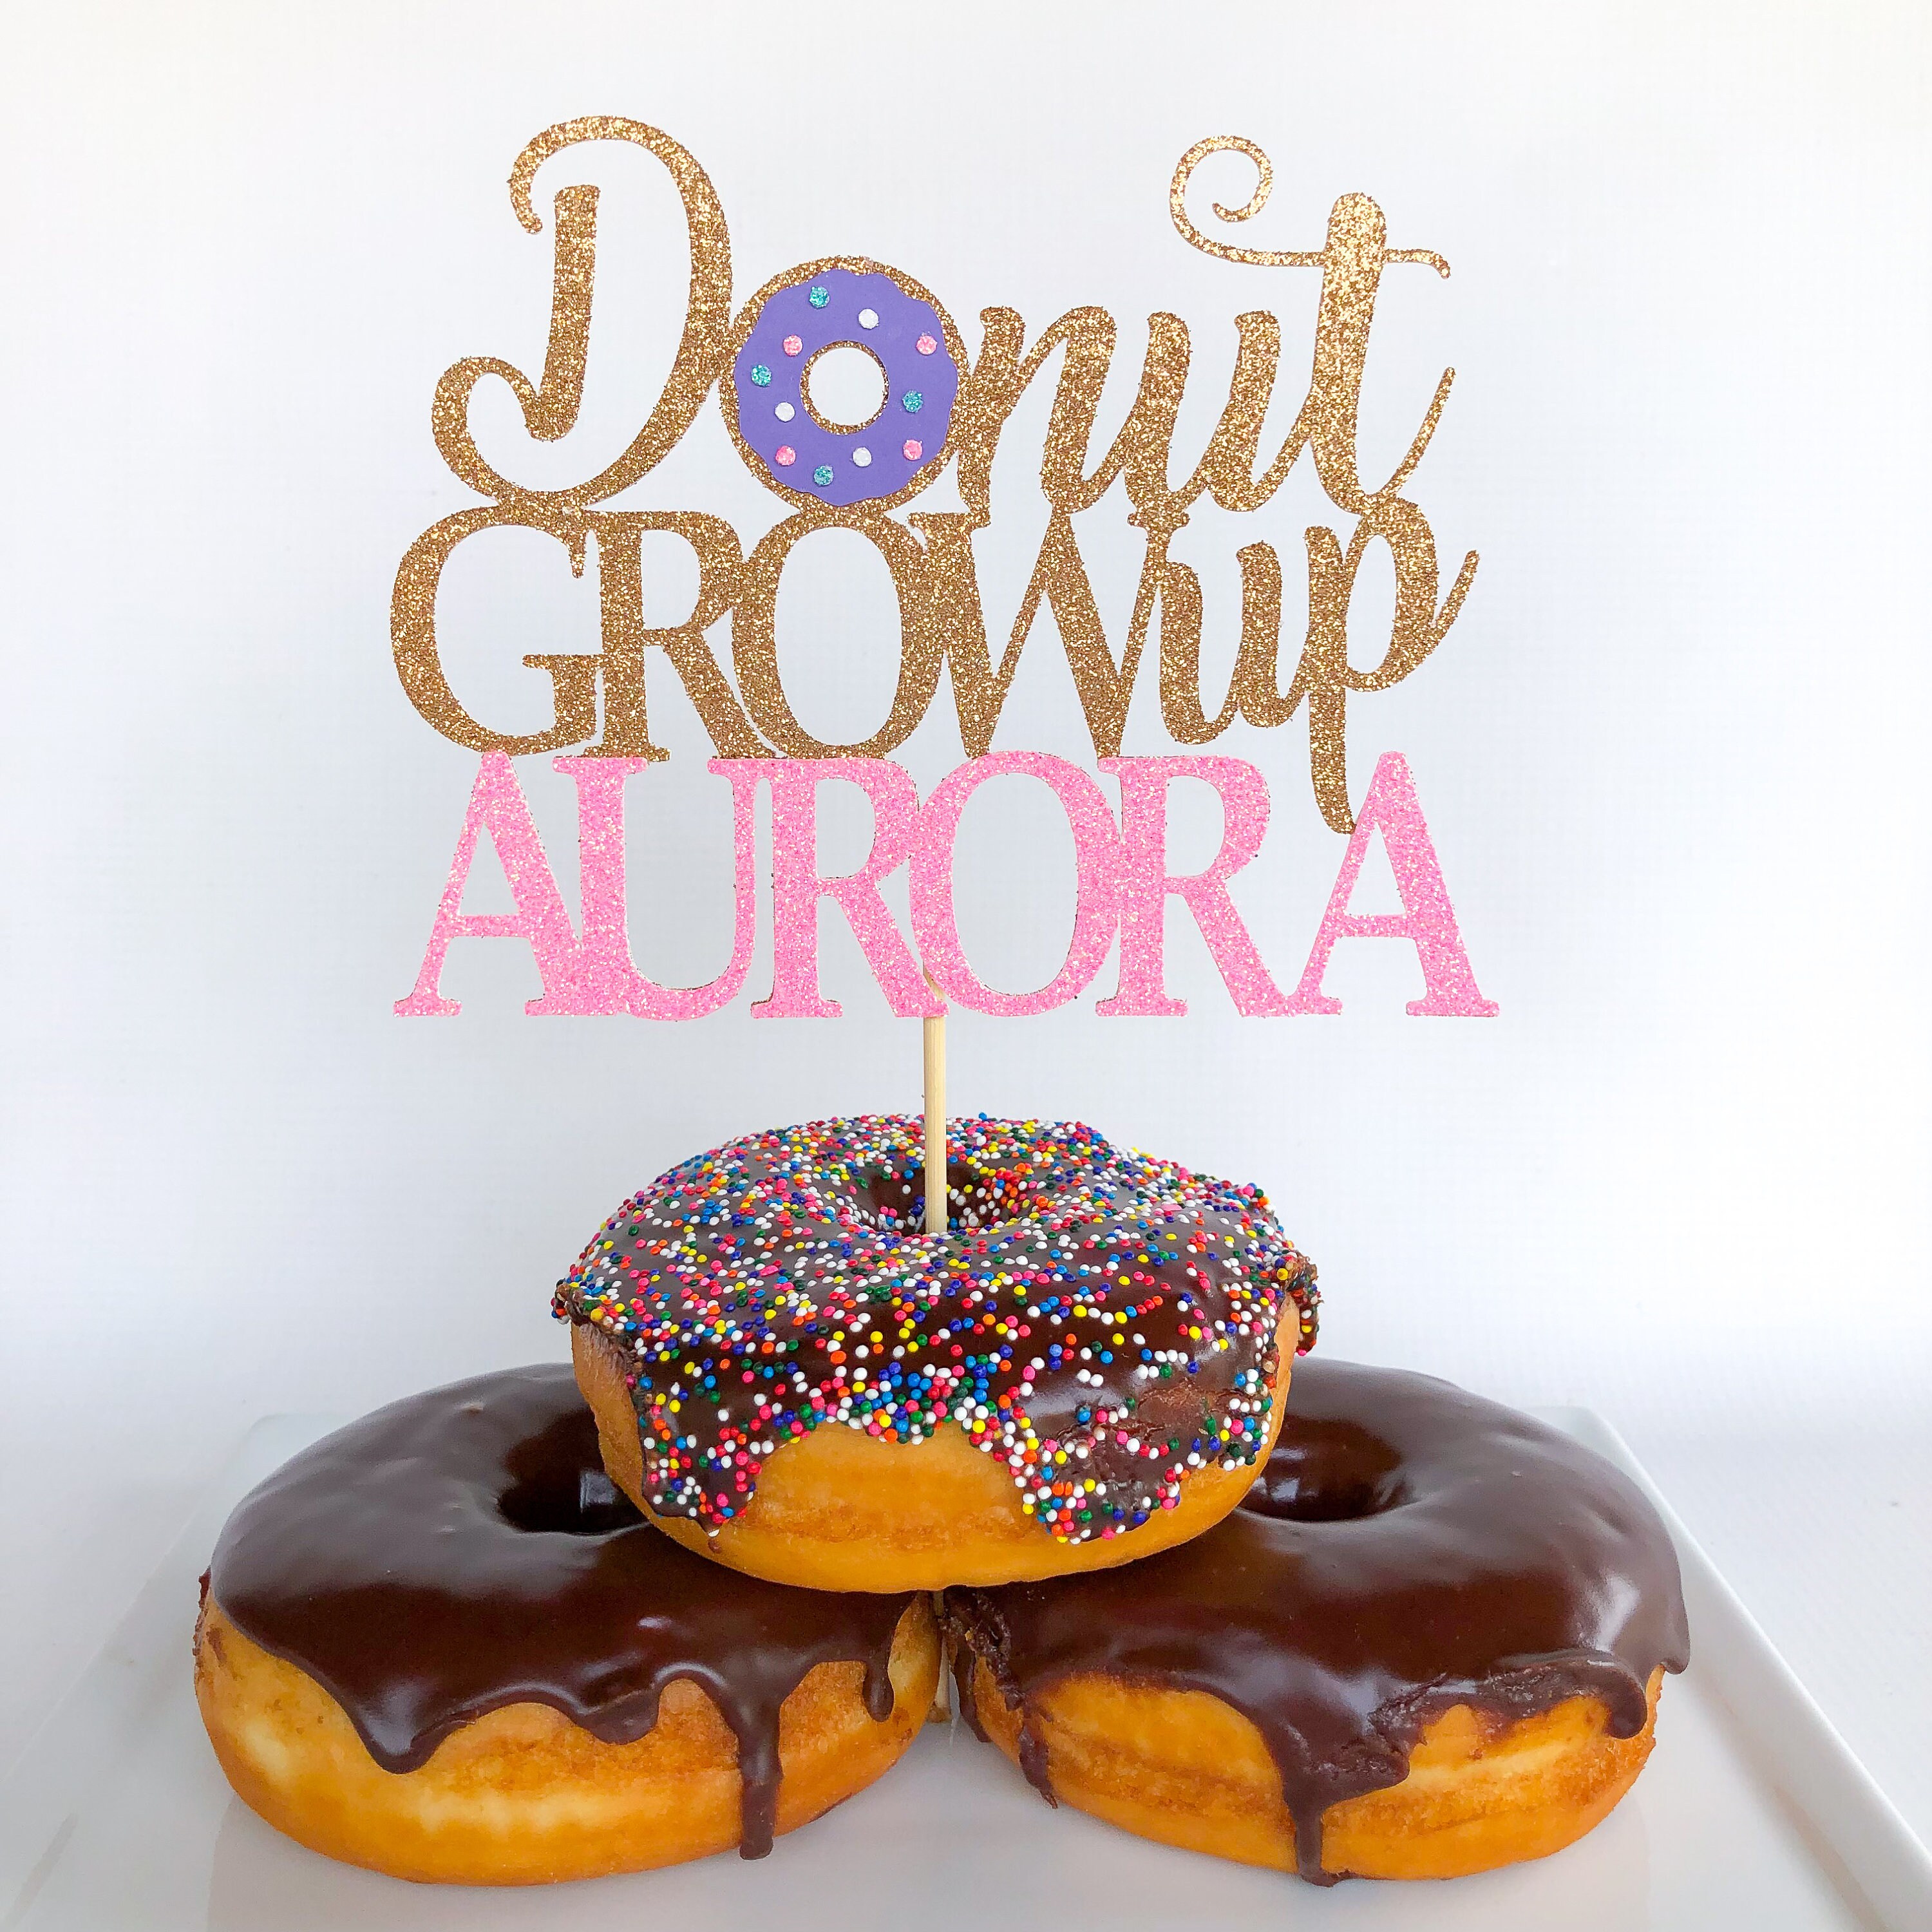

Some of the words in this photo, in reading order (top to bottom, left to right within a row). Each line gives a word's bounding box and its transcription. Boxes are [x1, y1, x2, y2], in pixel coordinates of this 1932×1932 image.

[432, 116, 1453, 514] Donut
[390, 504, 1189, 761] GROW
[1159, 497, 1479, 835] up
[393, 750, 1500, 1020] AURORA
